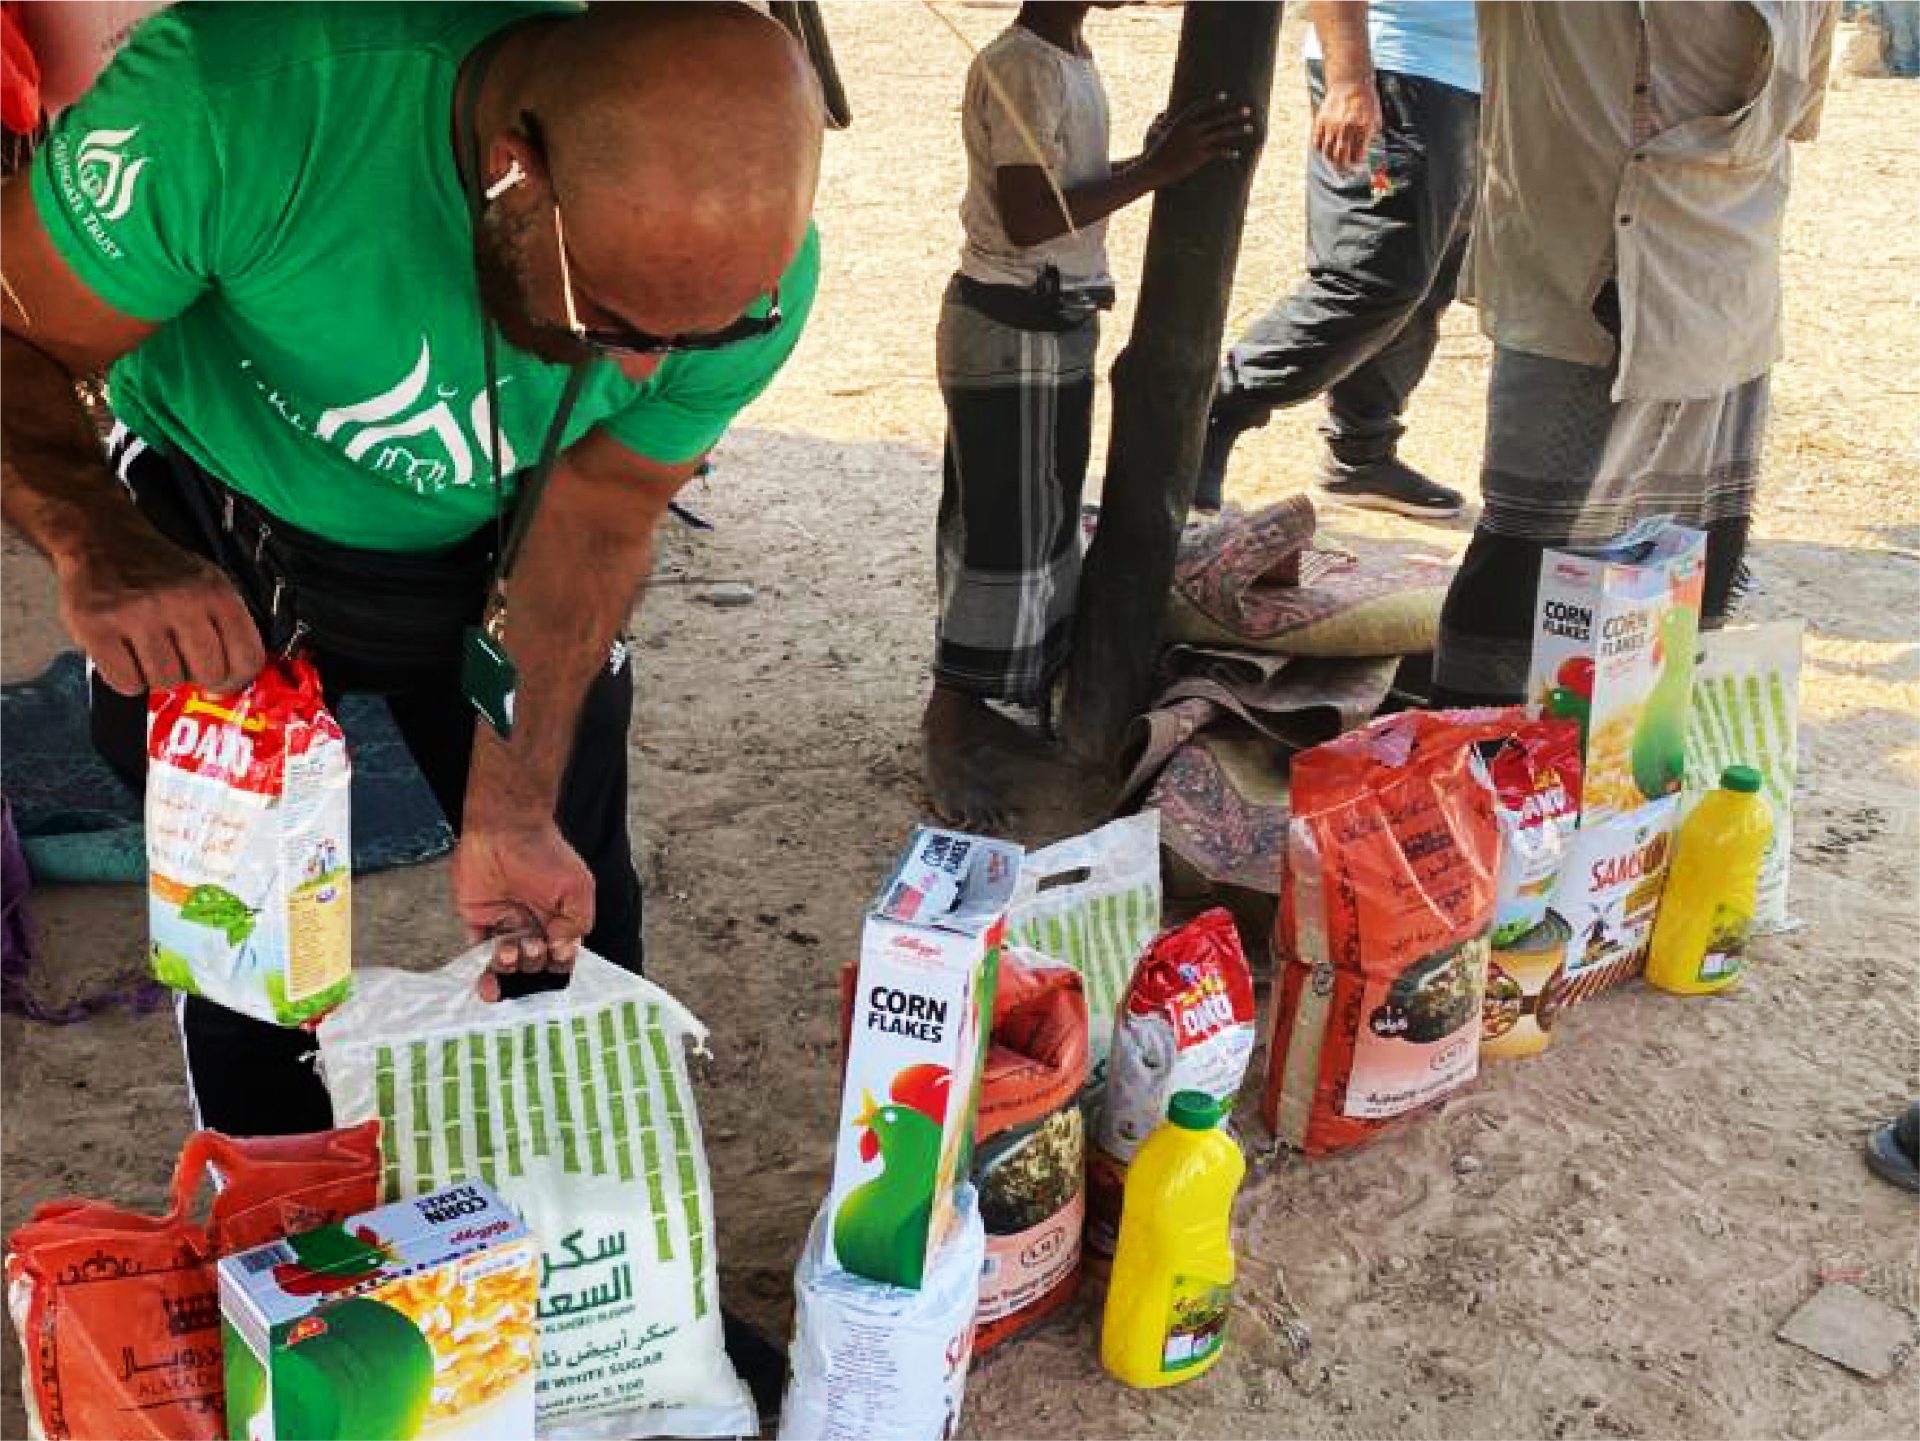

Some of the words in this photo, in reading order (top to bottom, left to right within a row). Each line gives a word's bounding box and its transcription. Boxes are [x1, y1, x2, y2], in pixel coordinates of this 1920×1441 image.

[1545, 601, 1593, 627] CORN
[871, 986, 948, 1025] CORN
[867, 1011, 943, 1044] FLAKES
[540, 1229, 626, 1288] سكر
